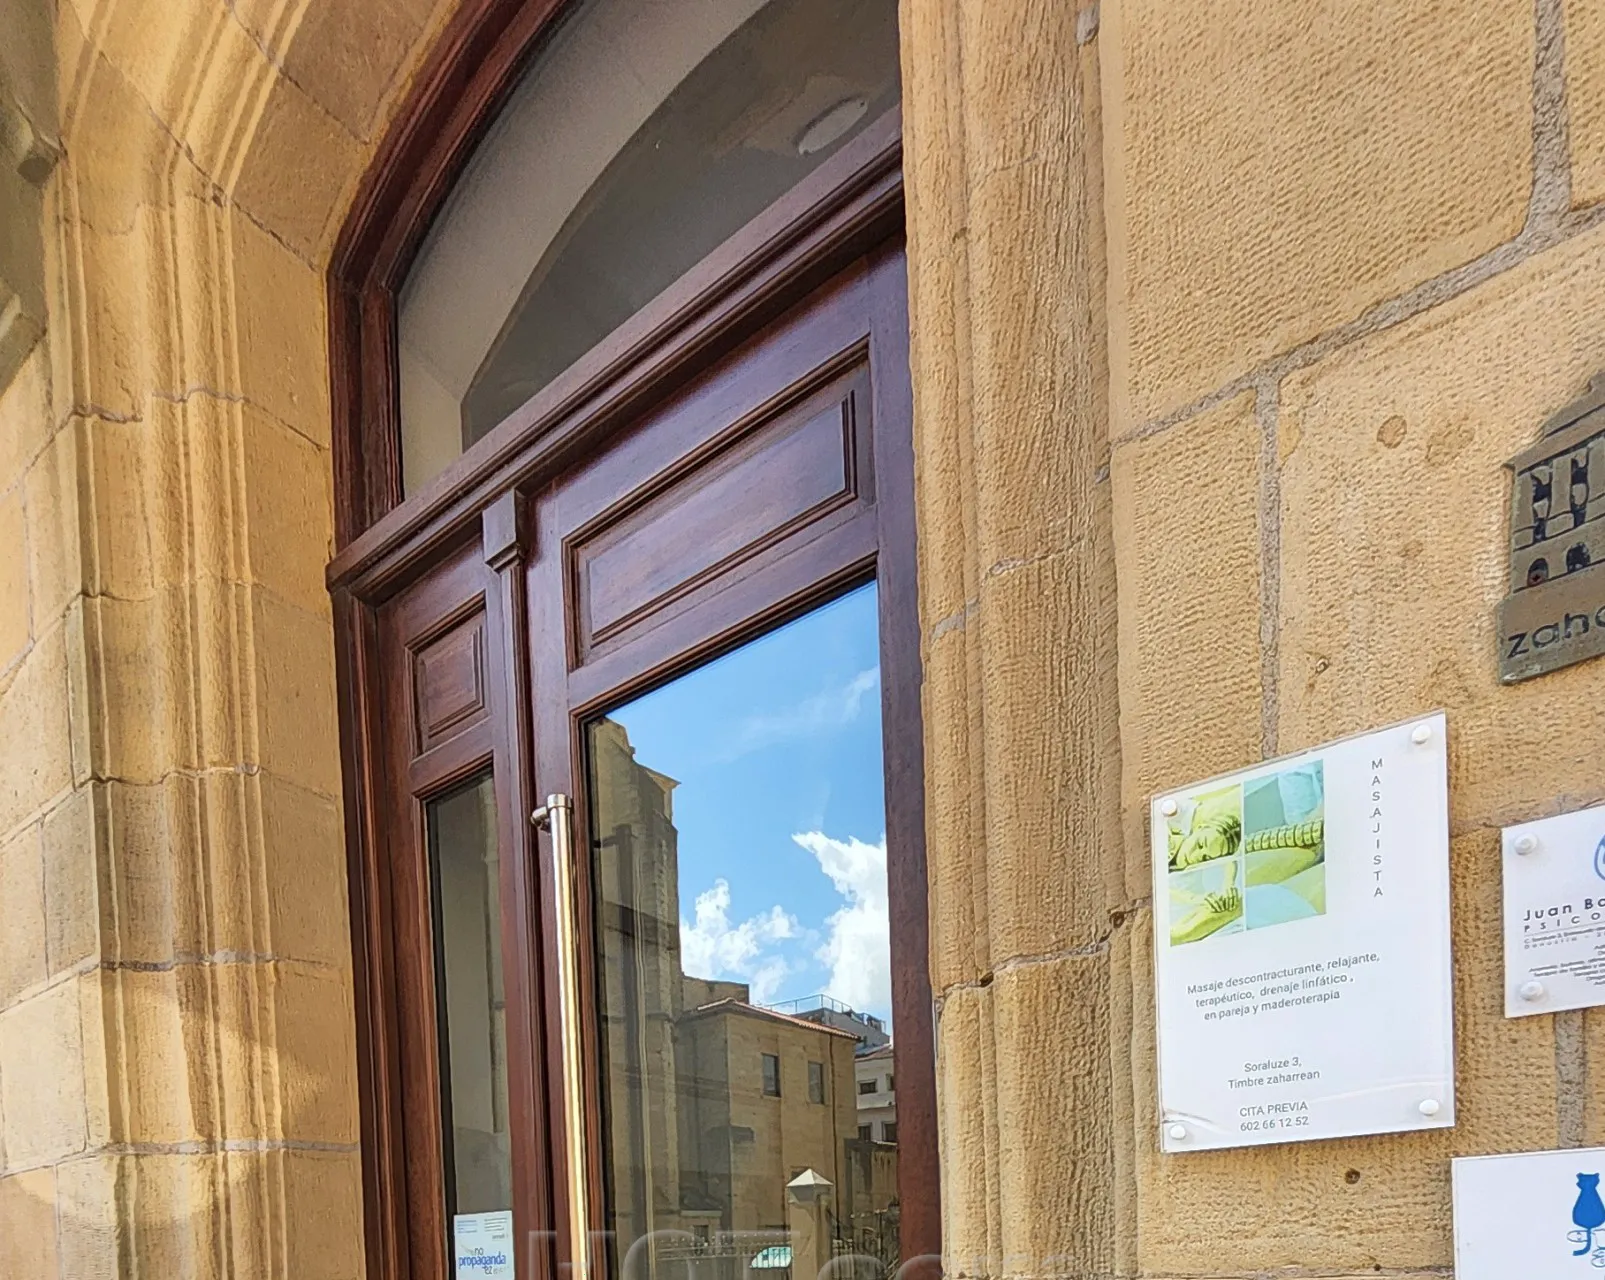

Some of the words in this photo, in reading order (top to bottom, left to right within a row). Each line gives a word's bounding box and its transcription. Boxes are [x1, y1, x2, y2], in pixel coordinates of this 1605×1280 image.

[1369, 757, 1384, 898] MASAJISTA
[1523, 904, 1572, 921] Juan
[1187, 981, 1224, 995] Masaje
[1225, 963, 1325, 988] descontracturante,
[1327, 953, 1380, 969] relajante,
[1195, 991, 1255, 1007] terapéutico,
[1260, 982, 1300, 997] drenaje
[1204, 1012, 1217, 1021] en
[1219, 1006, 1250, 1021] pareja
[1252, 1004, 1259, 1014] y
[1261, 990, 1341, 1011] maderoterapia
[1244, 1059, 1290, 1072] Soraluze
[1292, 1057, 1302, 1067] 3,
[1228, 1077, 1264, 1089] Timbre
[1267, 1070, 1320, 1085] zaharrean
[1240, 1106, 1265, 1117] CITA
[1267, 1101, 1308, 1114] PREVIA
[1240, 1121, 1260, 1131] 602
[1263, 1119, 1276, 1129] 66
[1279, 1118, 1292, 1127] 12
[1295, 1116, 1309, 1126] 52
[459, 1251, 506, 1269] propaganda
[474, 1247, 484, 1256] no
